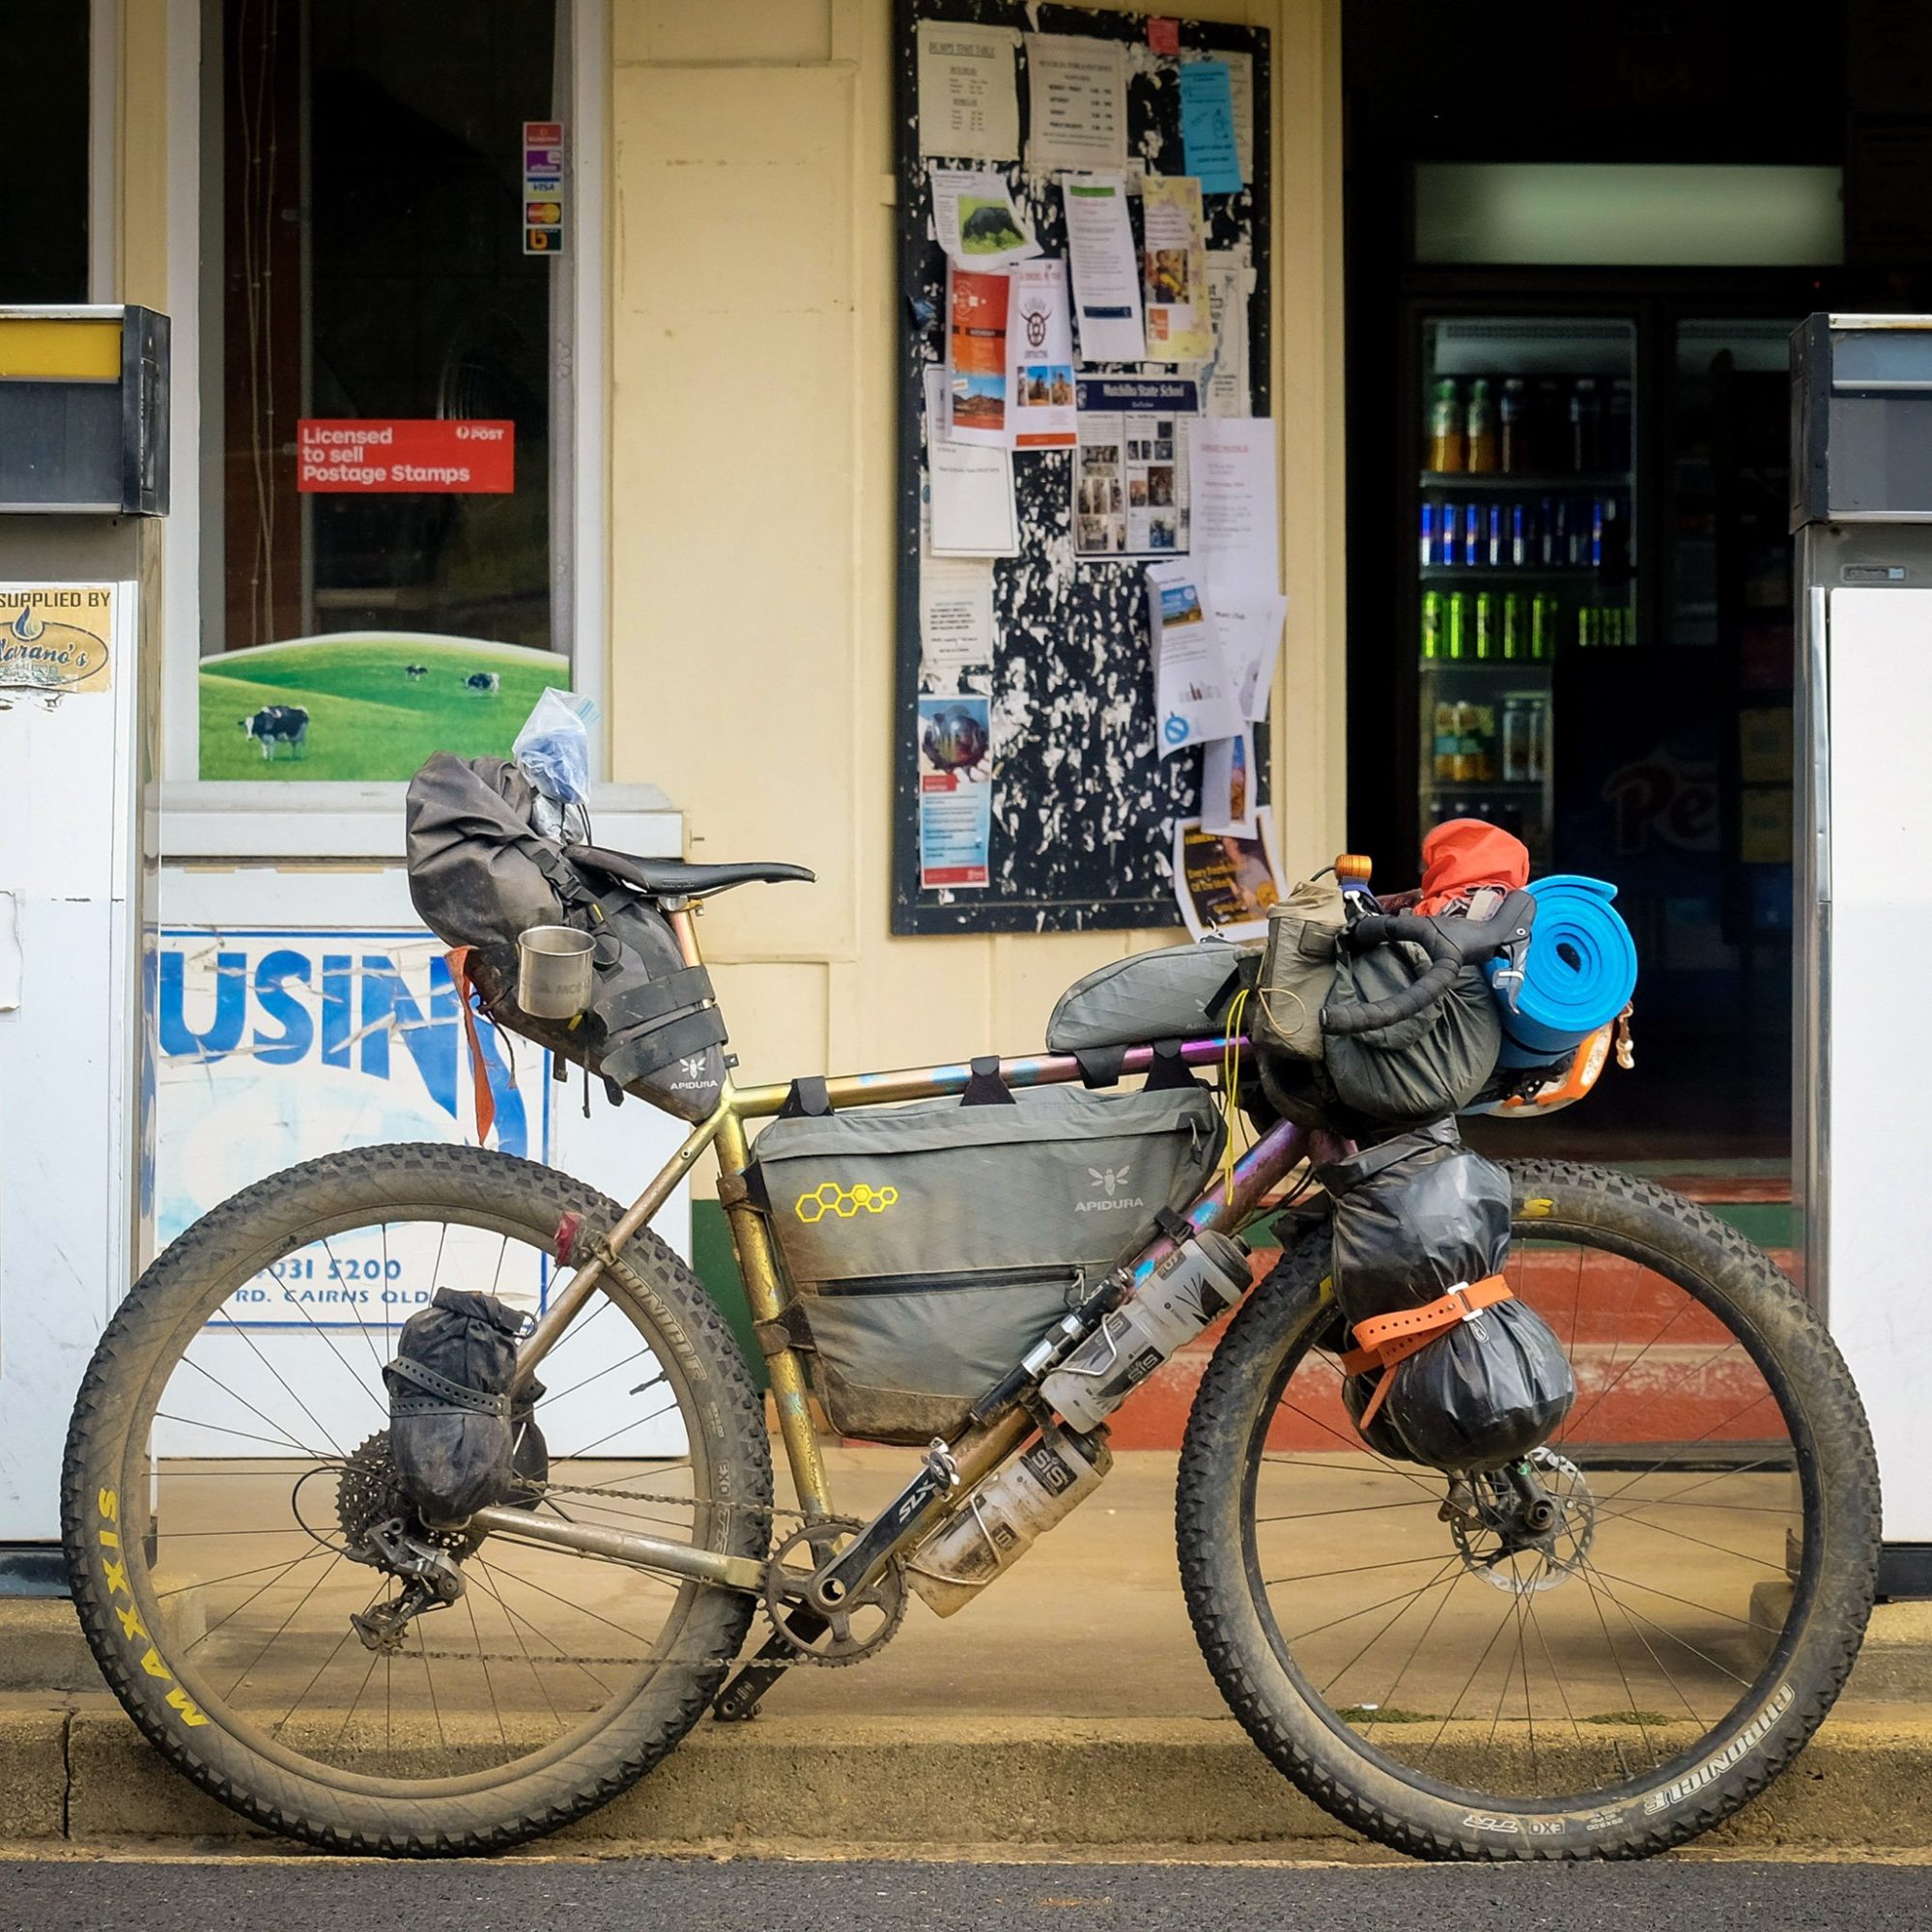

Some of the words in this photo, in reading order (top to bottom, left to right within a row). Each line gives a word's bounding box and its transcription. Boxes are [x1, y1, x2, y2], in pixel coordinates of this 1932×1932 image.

[533, 183, 555, 192] VISA
[303, 427, 393, 444] Licensed
[470, 429, 504, 440] POST
[303, 446, 325, 463] to
[330, 446, 363, 463] sell
[303, 465, 387, 485] Postage
[391, 465, 470, 485] Stamps
[88, 591, 111, 608] BY
[669, 1079, 718, 1091] APIDURA
[1074, 1197, 1144, 1212] APIDURA
[256, 1259, 313, 1280] 031
[327, 1259, 402, 1281] 5200
[235, 1290, 271, 1303] RD.
[285, 1289, 369, 1304] CAIRNS
[381, 1290, 429, 1304] QLD
[610, 1256, 708, 1381] RONICLE
[717, 1461, 731, 1495] EXO
[898, 1481, 936, 1524] SLX
[99, 1488, 210, 1728] MAXXIS
[1644, 1683, 1796, 1816] CHRONICLE
[1529, 1821, 1565, 1834] EXO
